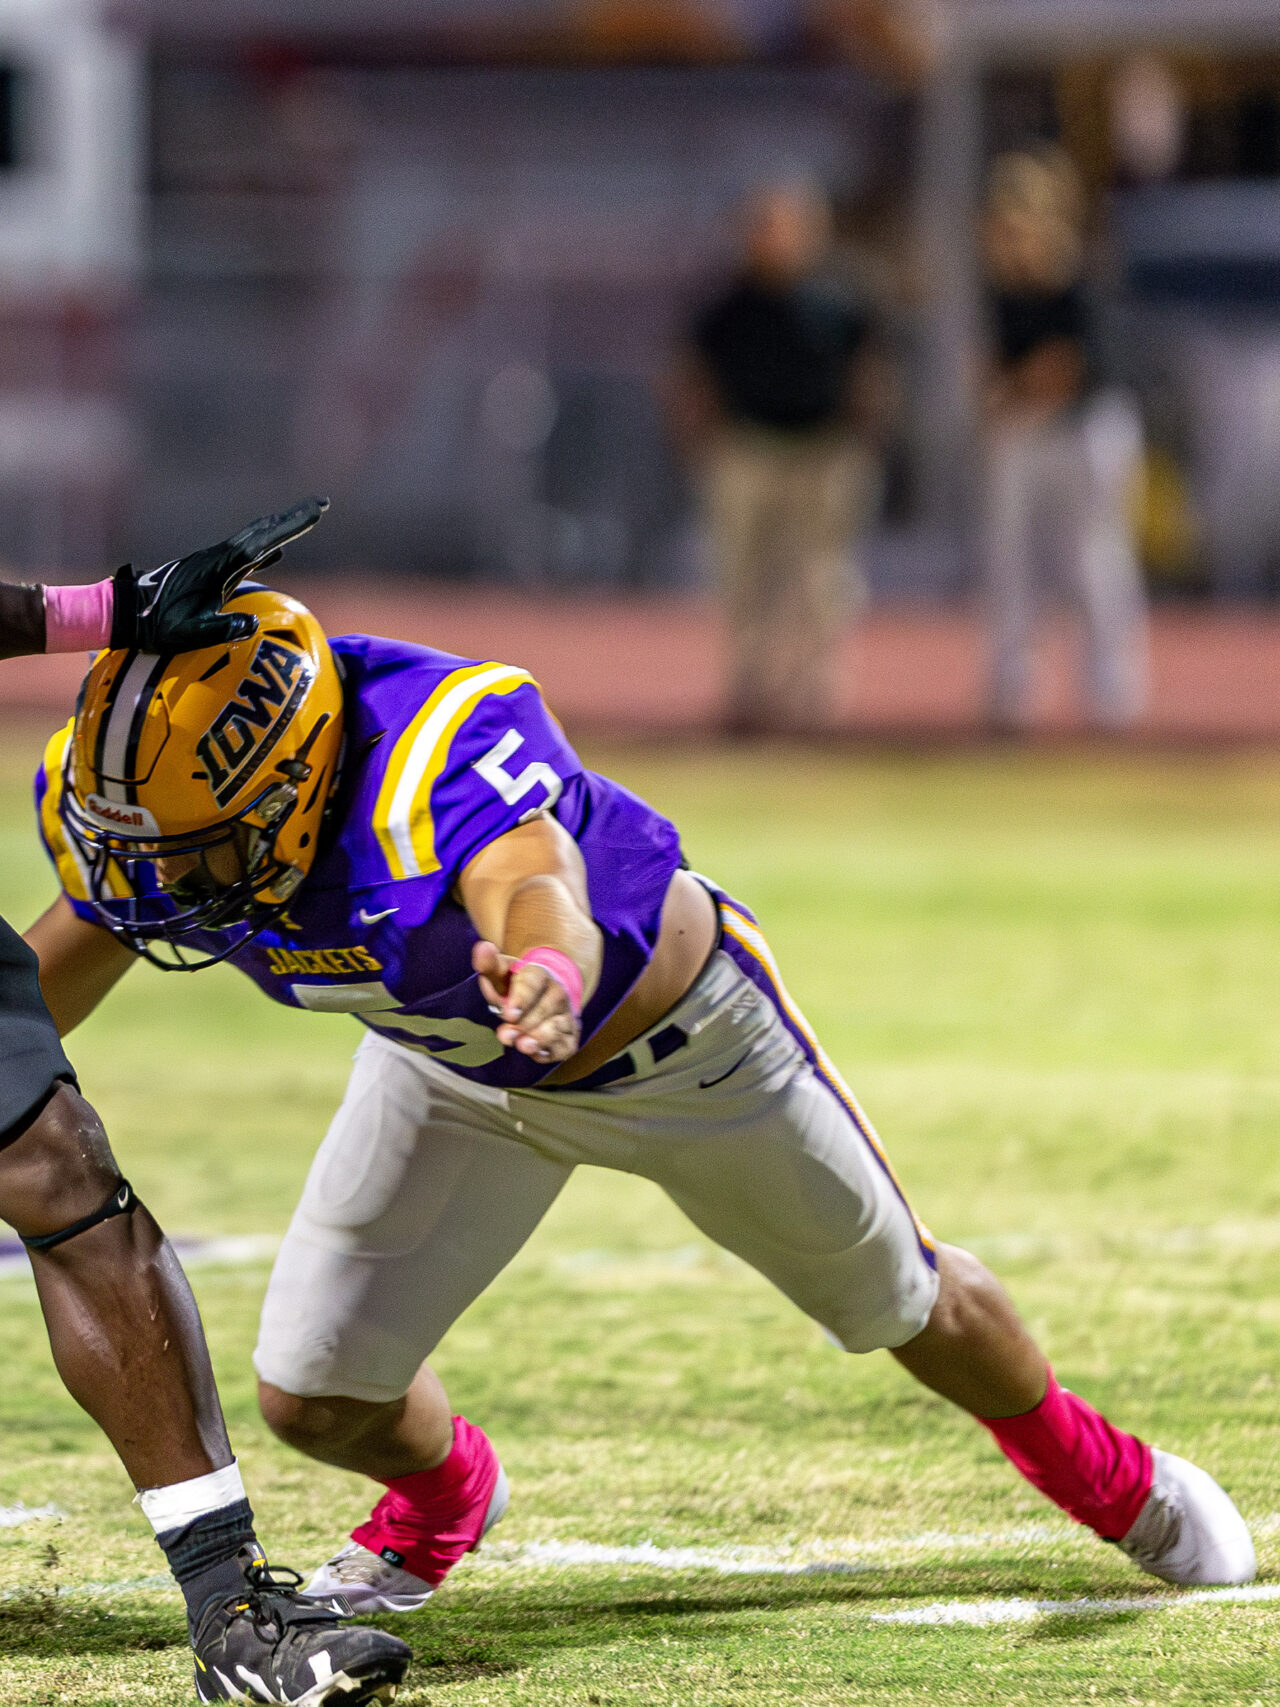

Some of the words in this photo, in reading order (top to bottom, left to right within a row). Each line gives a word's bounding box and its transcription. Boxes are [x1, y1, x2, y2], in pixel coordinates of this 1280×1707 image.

[196, 639, 306, 794] IOWA
[471, 728, 564, 824] 5
[266, 946, 383, 975] JACKETS
